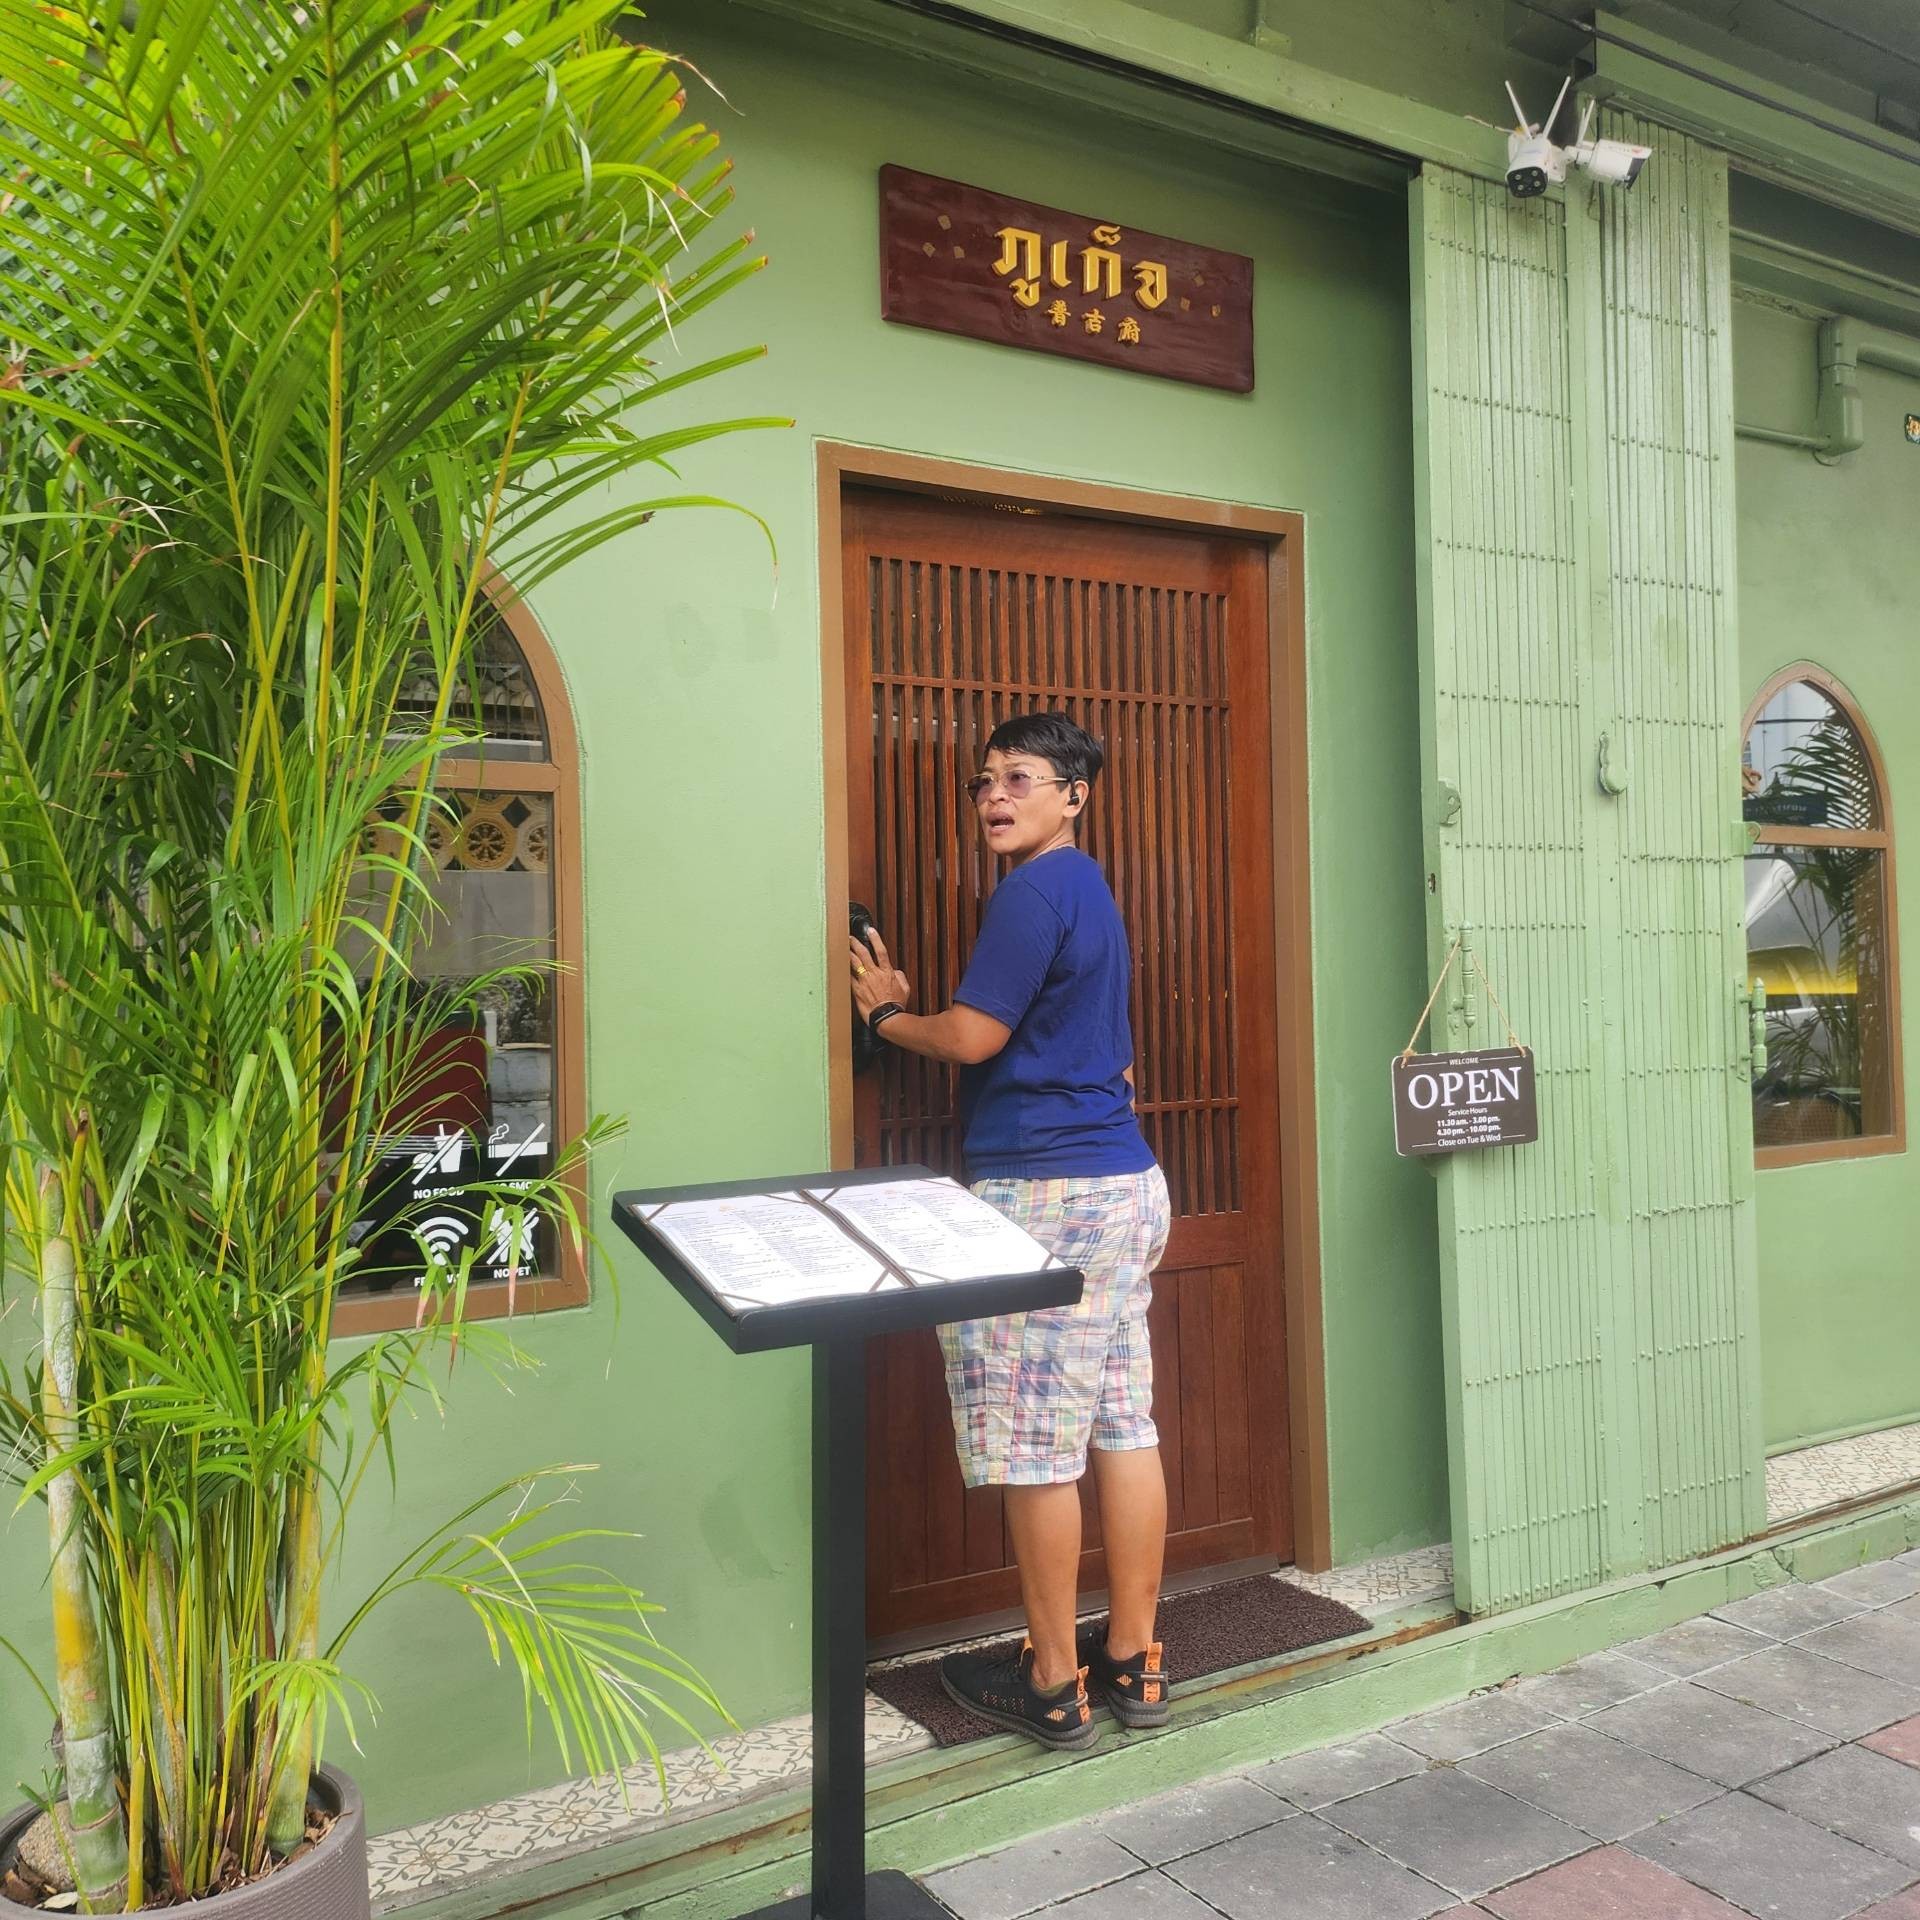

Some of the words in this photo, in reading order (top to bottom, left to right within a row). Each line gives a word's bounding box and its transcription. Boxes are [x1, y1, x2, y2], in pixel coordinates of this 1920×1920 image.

[1047, 299, 1142, 345] 普吉府
[1449, 1057, 1479, 1065] WELCOME
[1408, 1066, 1522, 1110] OPEN
[1437, 1119, 1455, 1127] 11.30
[1470, 1125, 1488, 1133] 10.00
[1438, 1139, 1456, 1147] Close
[1467, 1136, 1479, 1144] Tue
[1480, 1135, 1485, 1143] &
[1486, 1133, 1501, 1142] Wed
[413, 1188, 431, 1200] NO
[493, 1267, 510, 1279] NO
